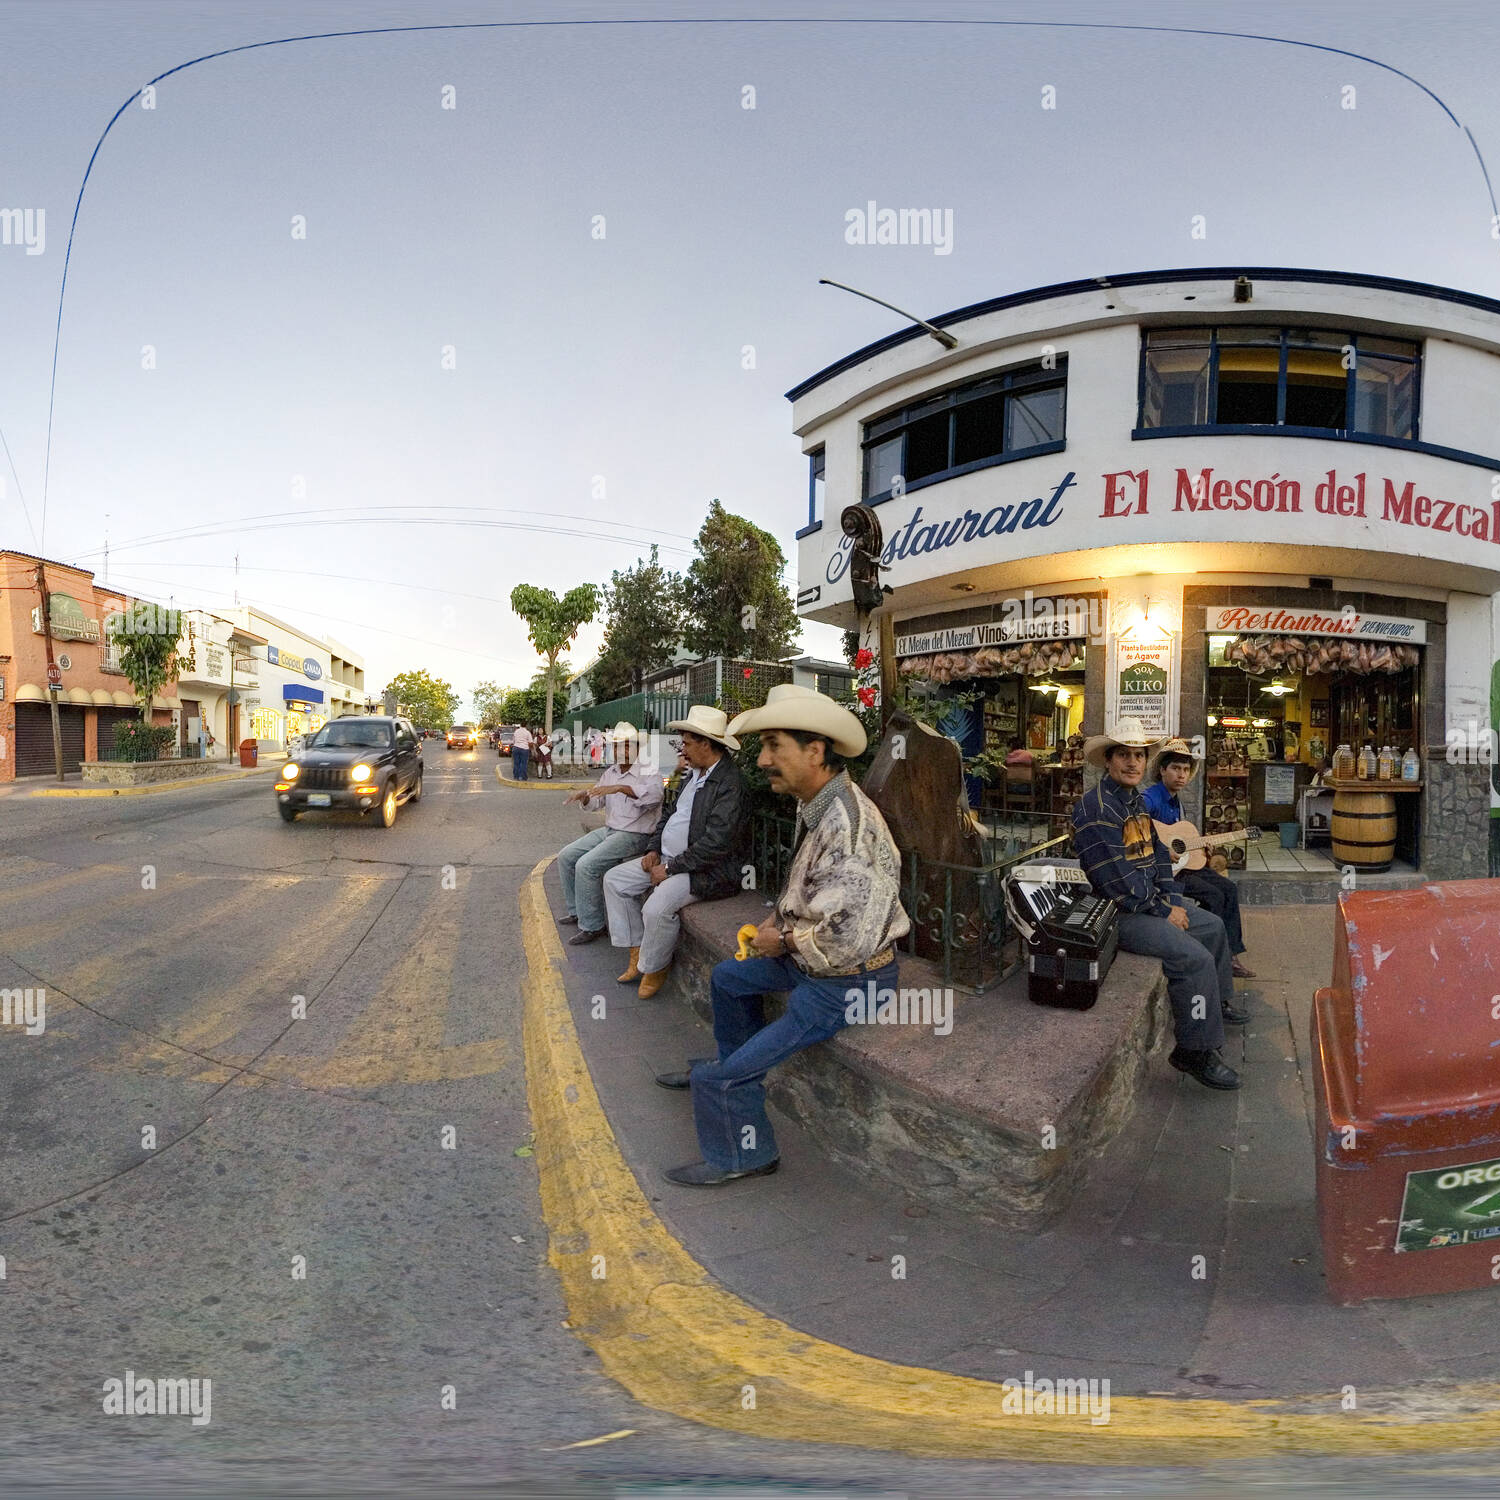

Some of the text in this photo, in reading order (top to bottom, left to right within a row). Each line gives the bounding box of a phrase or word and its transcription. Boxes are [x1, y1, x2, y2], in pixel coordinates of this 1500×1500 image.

[1098, 469, 1149, 518] El
[1171, 467, 1304, 513] Mesón
[1314, 469, 1368, 518] del
[1215, 608, 1361, 635] Restaurant
[931, 631, 945, 650] del
[946, 627, 976, 648] Mezcal
[977, 625, 1008, 646] Vinos
[1016, 619, 1070, 641] Licores
[188, 620, 197, 673] PEDIATRA
[281, 654, 302, 671] Coppel
[1134, 652, 1160, 662] Agave
[48, 669, 61, 679] ALTO
[303, 661, 322, 677] CANADA
[1133, 665, 1155, 676] DON
[1124, 680, 1163, 692] KIKO
